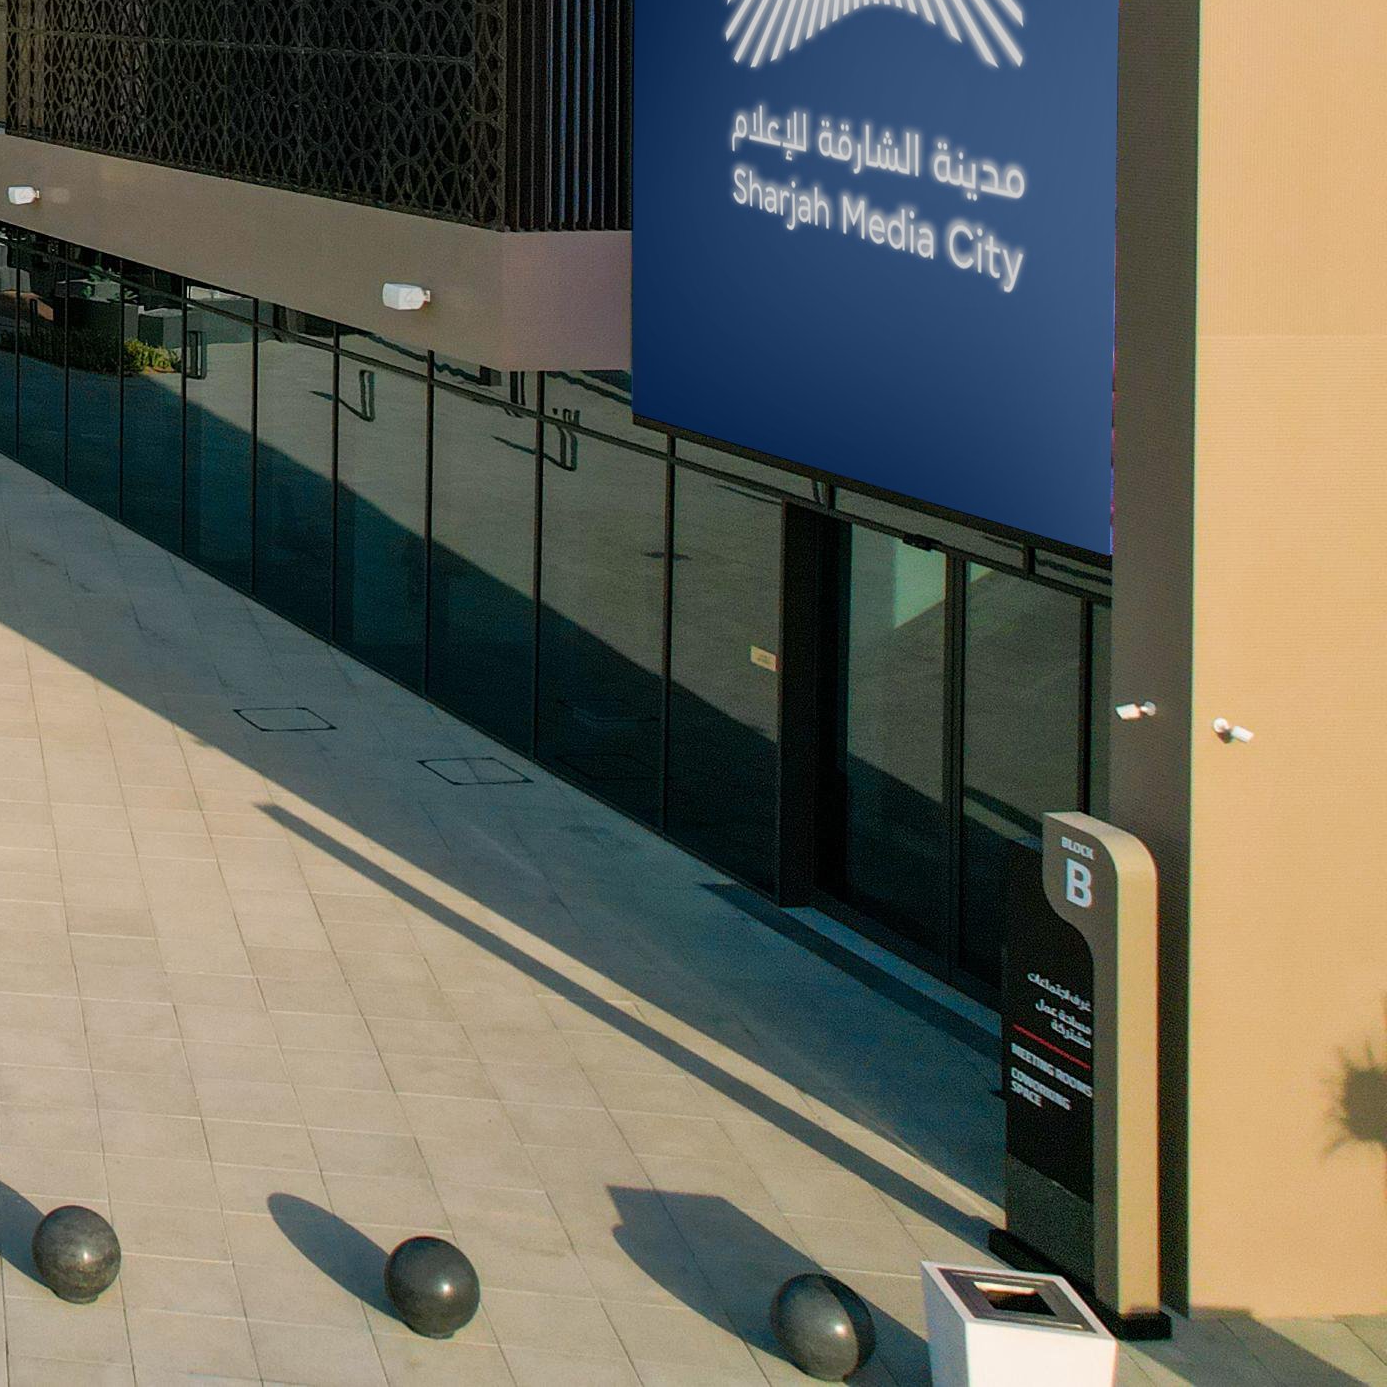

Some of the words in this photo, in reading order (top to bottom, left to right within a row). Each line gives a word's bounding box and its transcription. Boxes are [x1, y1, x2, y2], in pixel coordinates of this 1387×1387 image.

[731, 104, 808, 161] للإعلام
[818, 118, 920, 177] الشارقة
[933, 140, 1026, 201] مدينة
[732, 168, 830, 230] Sharjah
[841, 195, 934, 260] Media
[948, 223, 1024, 293] City
[1061, 836, 1094, 861] BLOCK
[1067, 857, 1092, 908] B
[1011, 1042, 1055, 1077] MEETING
[1054, 1067, 1093, 1098] ROOMS
[1011, 1080, 1043, 1107] SPACE
